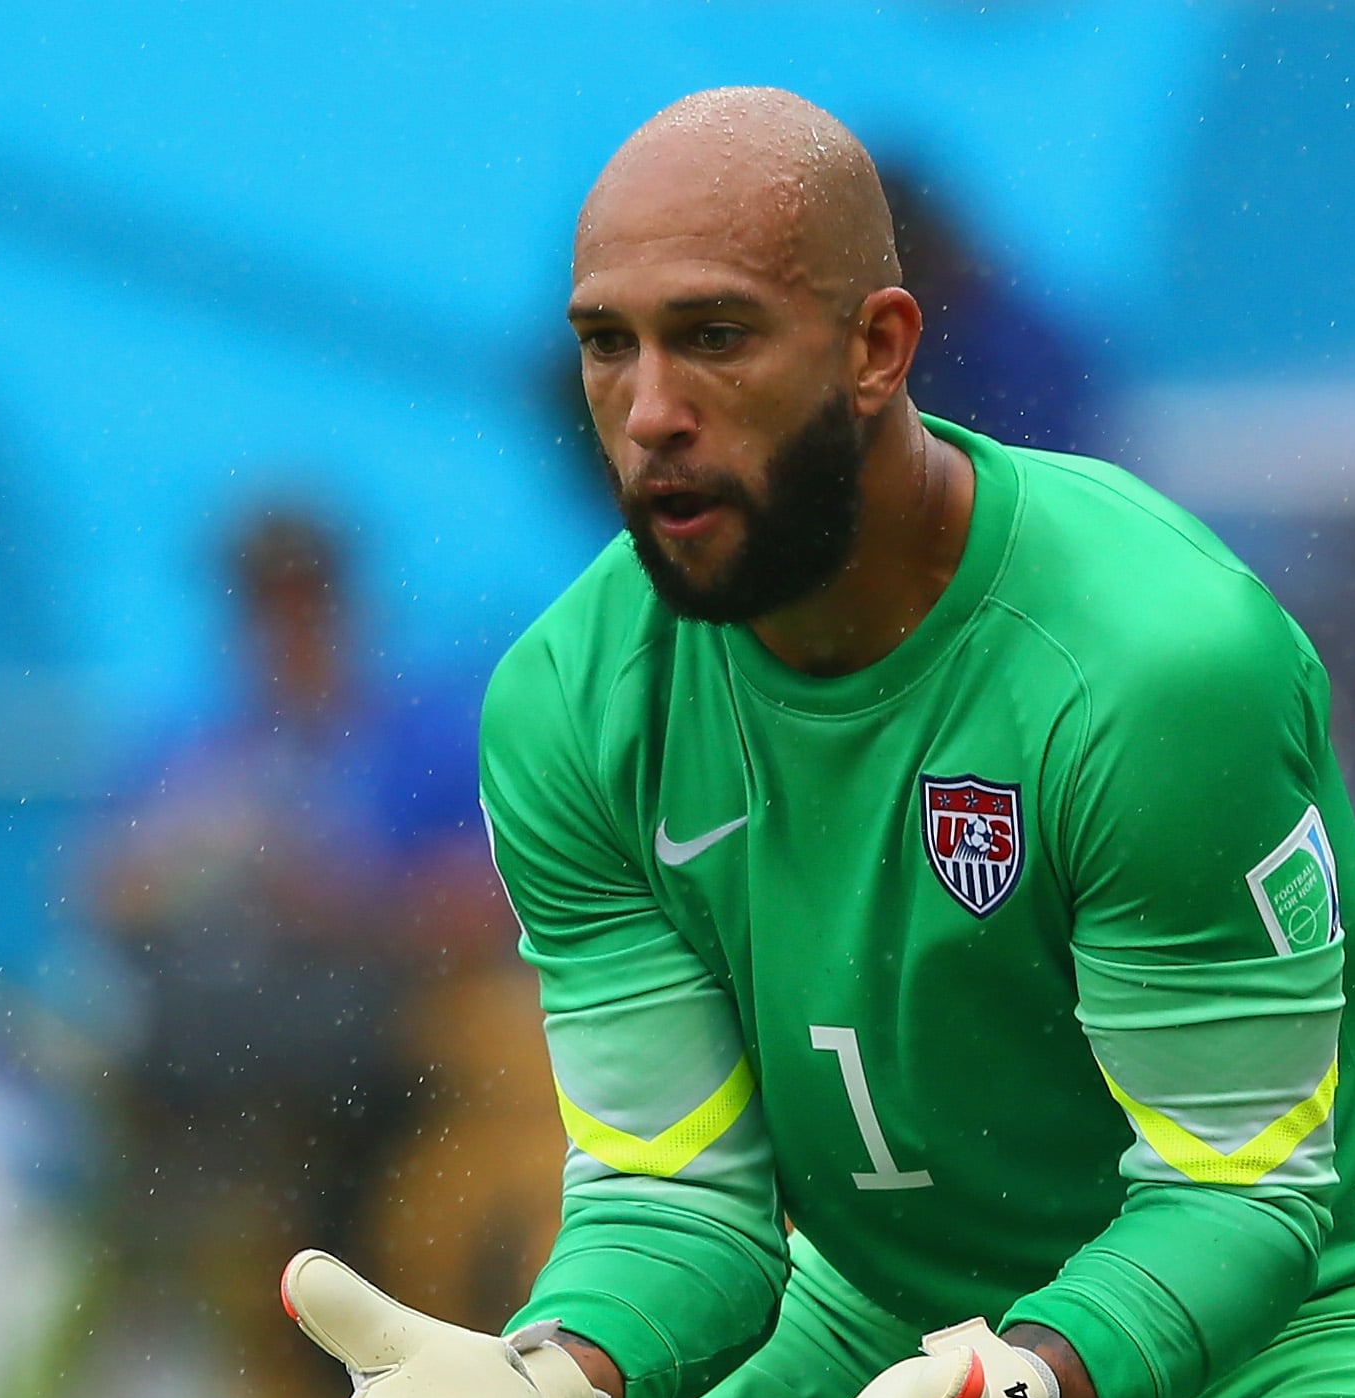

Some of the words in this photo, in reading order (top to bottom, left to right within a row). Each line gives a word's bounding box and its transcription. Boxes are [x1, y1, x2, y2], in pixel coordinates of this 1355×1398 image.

[936, 815, 1014, 863] US
[1273, 861, 1315, 905] FOOTBALL
[1278, 894, 1299, 916] FOR
[809, 1024, 935, 1190] 1
